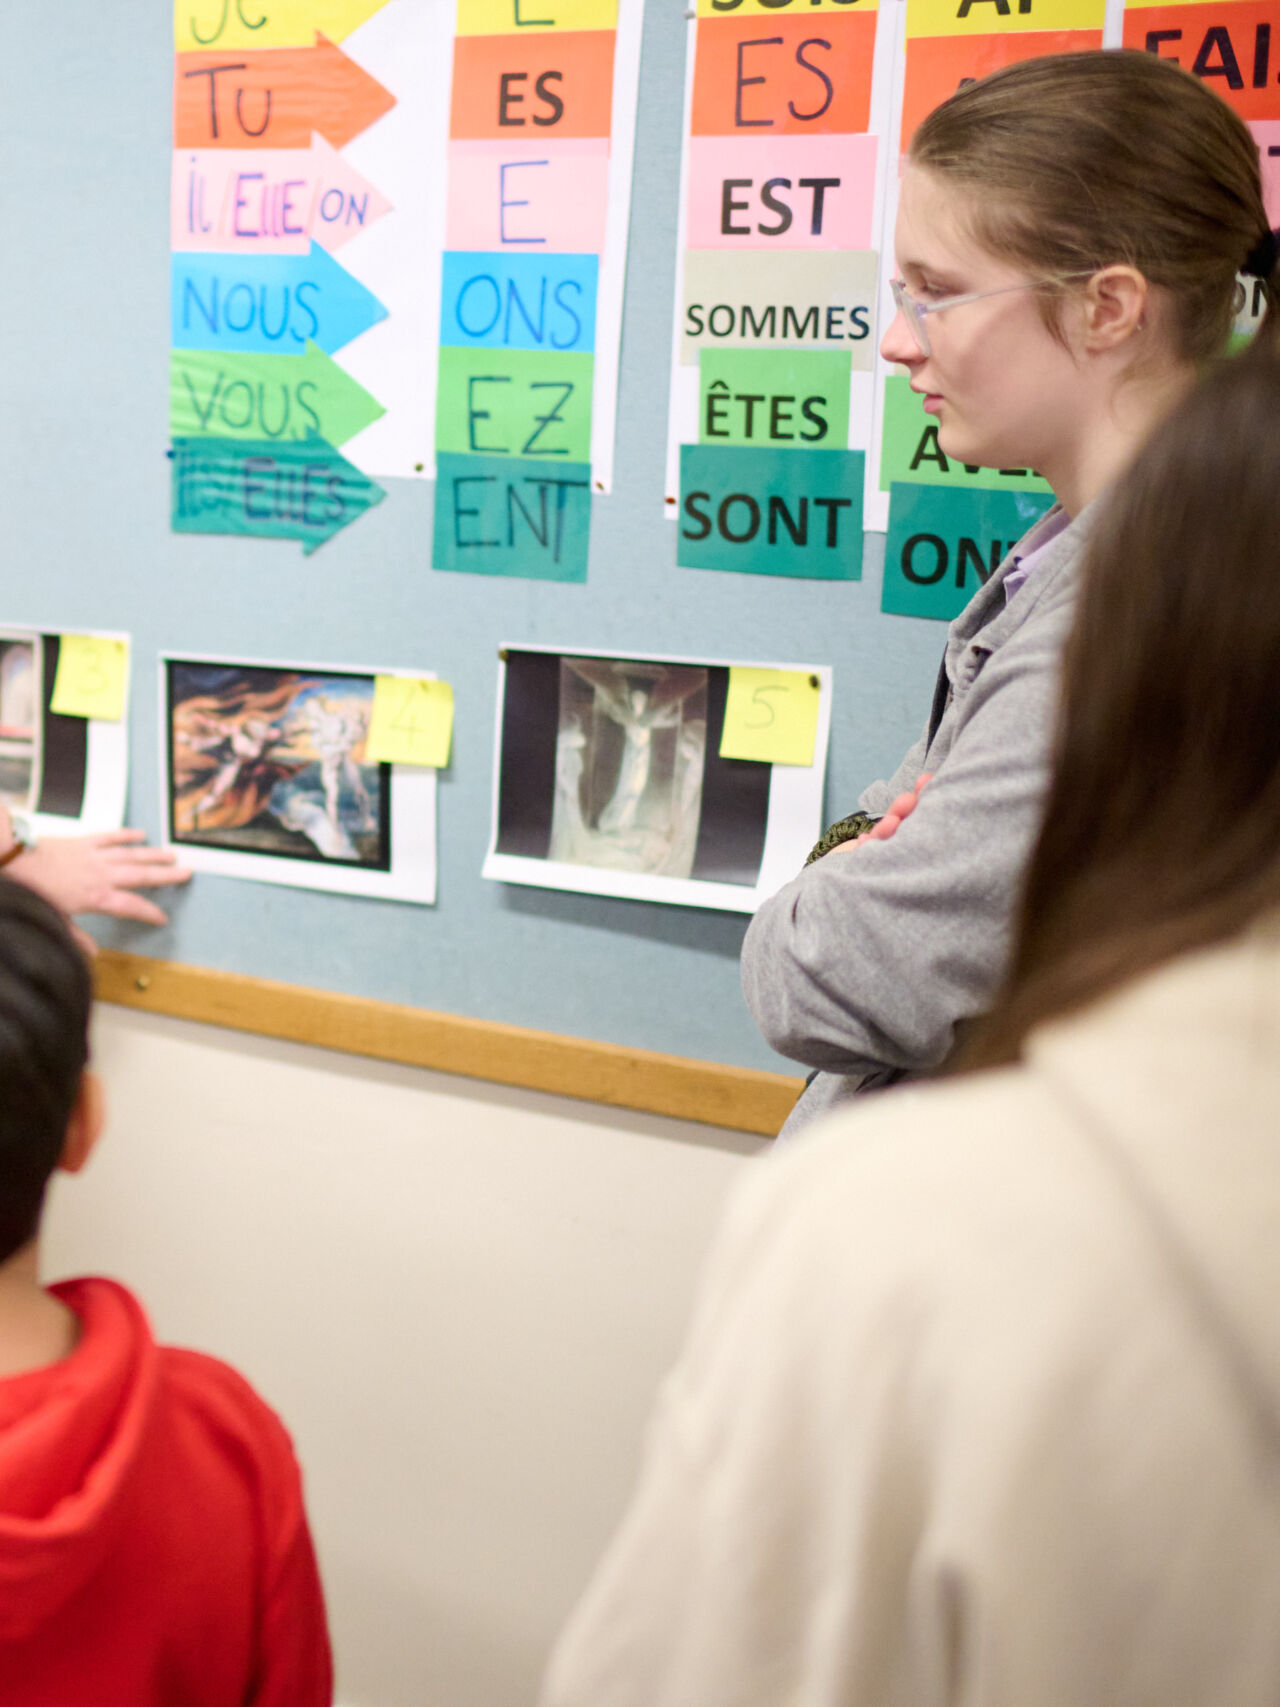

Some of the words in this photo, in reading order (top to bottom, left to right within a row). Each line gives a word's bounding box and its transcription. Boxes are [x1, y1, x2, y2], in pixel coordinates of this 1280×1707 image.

[735, 37, 834, 127] ES
[1144, 23, 1280, 90] FAI
[184, 63, 272, 139] TU
[498, 71, 564, 126] ES
[320, 188, 369, 226] ON
[499, 159, 549, 243] E
[721, 177, 841, 236] EST
[181, 276, 323, 342] NOUS
[455, 274, 583, 349] ONS
[685, 303, 870, 341] SOMMES
[182, 371, 322, 442] VOUS
[468, 375, 574, 454] EZ
[706, 380, 829, 441] ÊTES
[453, 475, 589, 563] ENT
[682, 490, 852, 548] SONT
[901, 533, 1019, 588] ON
[388, 686, 425, 748] 4
[744, 685, 789, 729] 5
